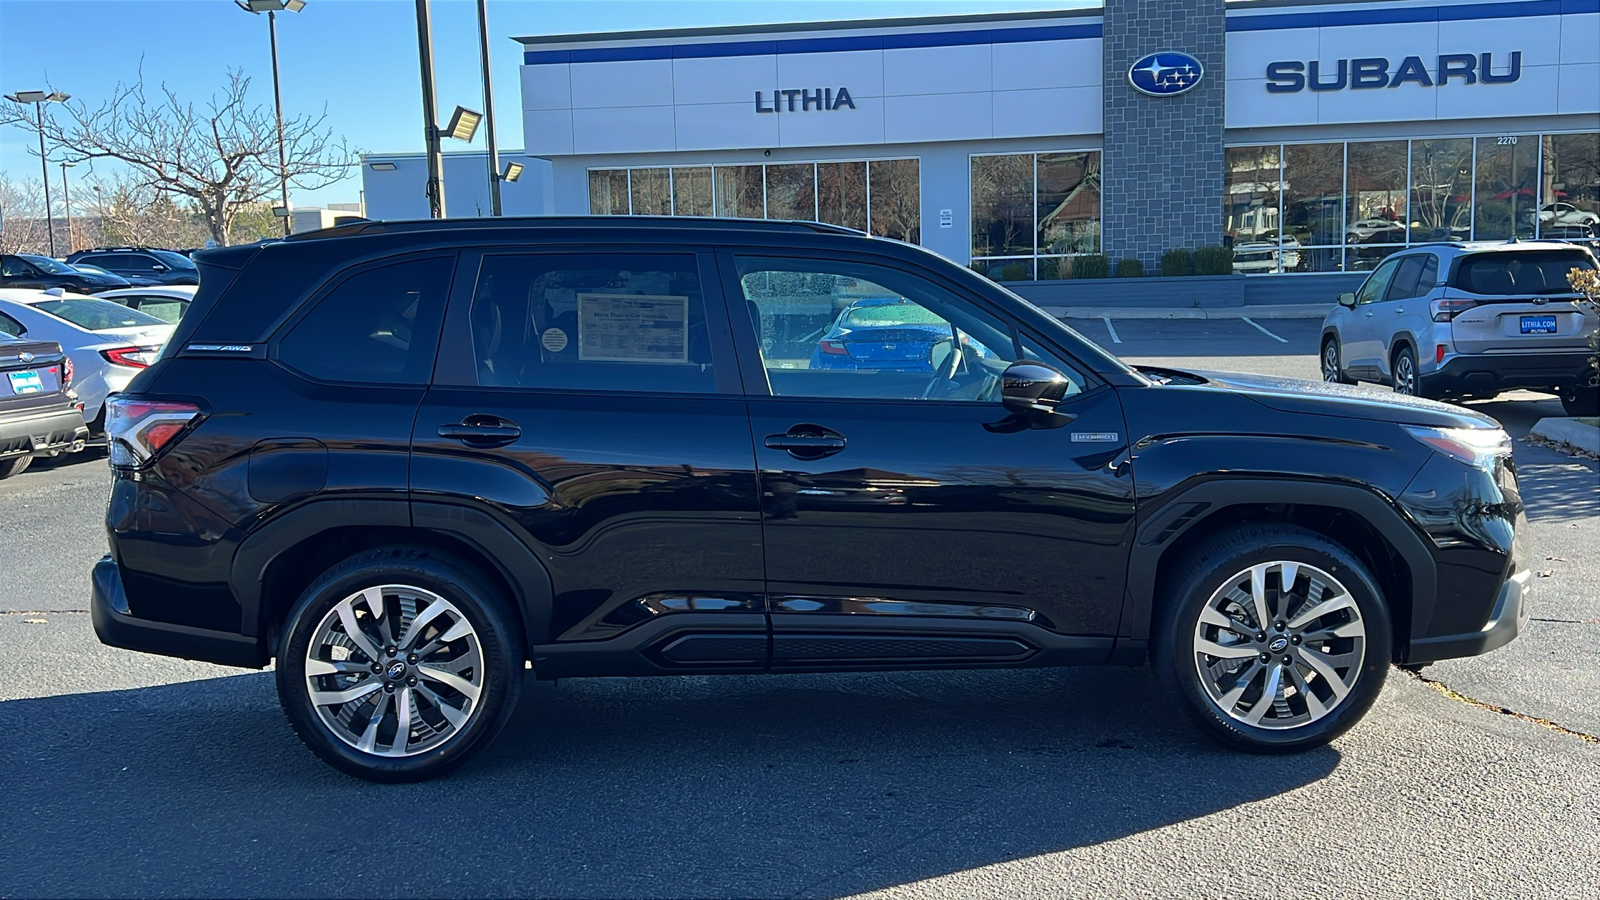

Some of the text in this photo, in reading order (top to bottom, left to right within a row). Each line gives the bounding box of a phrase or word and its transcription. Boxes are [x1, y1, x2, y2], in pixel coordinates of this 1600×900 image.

[1266, 50, 1522, 94] SUBARU
[755, 86, 856, 114] LITHIA
[1497, 136, 1518, 145] 2270
[1521, 320, 1556, 329] LITHIA.COM
